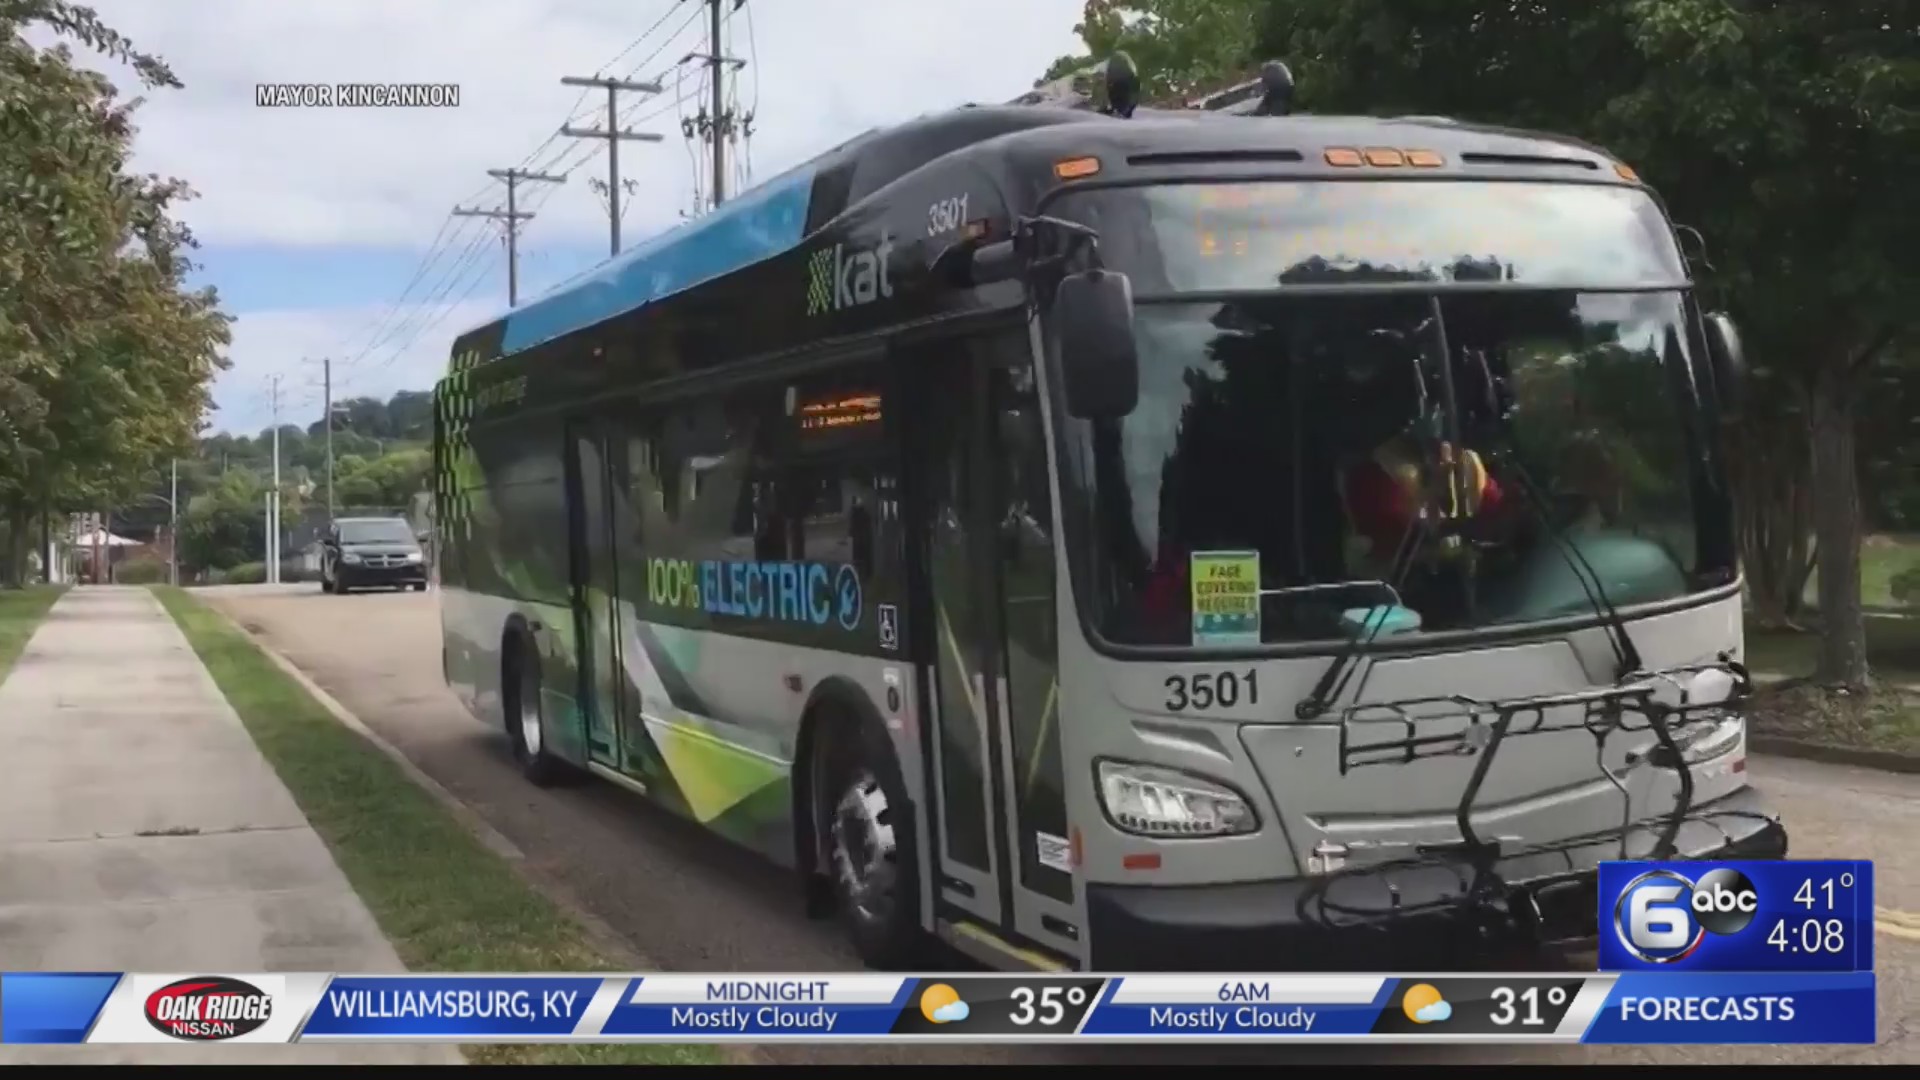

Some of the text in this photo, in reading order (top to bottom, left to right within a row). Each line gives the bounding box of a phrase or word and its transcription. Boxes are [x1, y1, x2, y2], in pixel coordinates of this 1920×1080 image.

[927, 192, 968, 237] 3501
[834, 226, 894, 310] kat
[647, 558, 831, 624] 100% ELECTRIC
[1165, 668, 1259, 711] 3501
